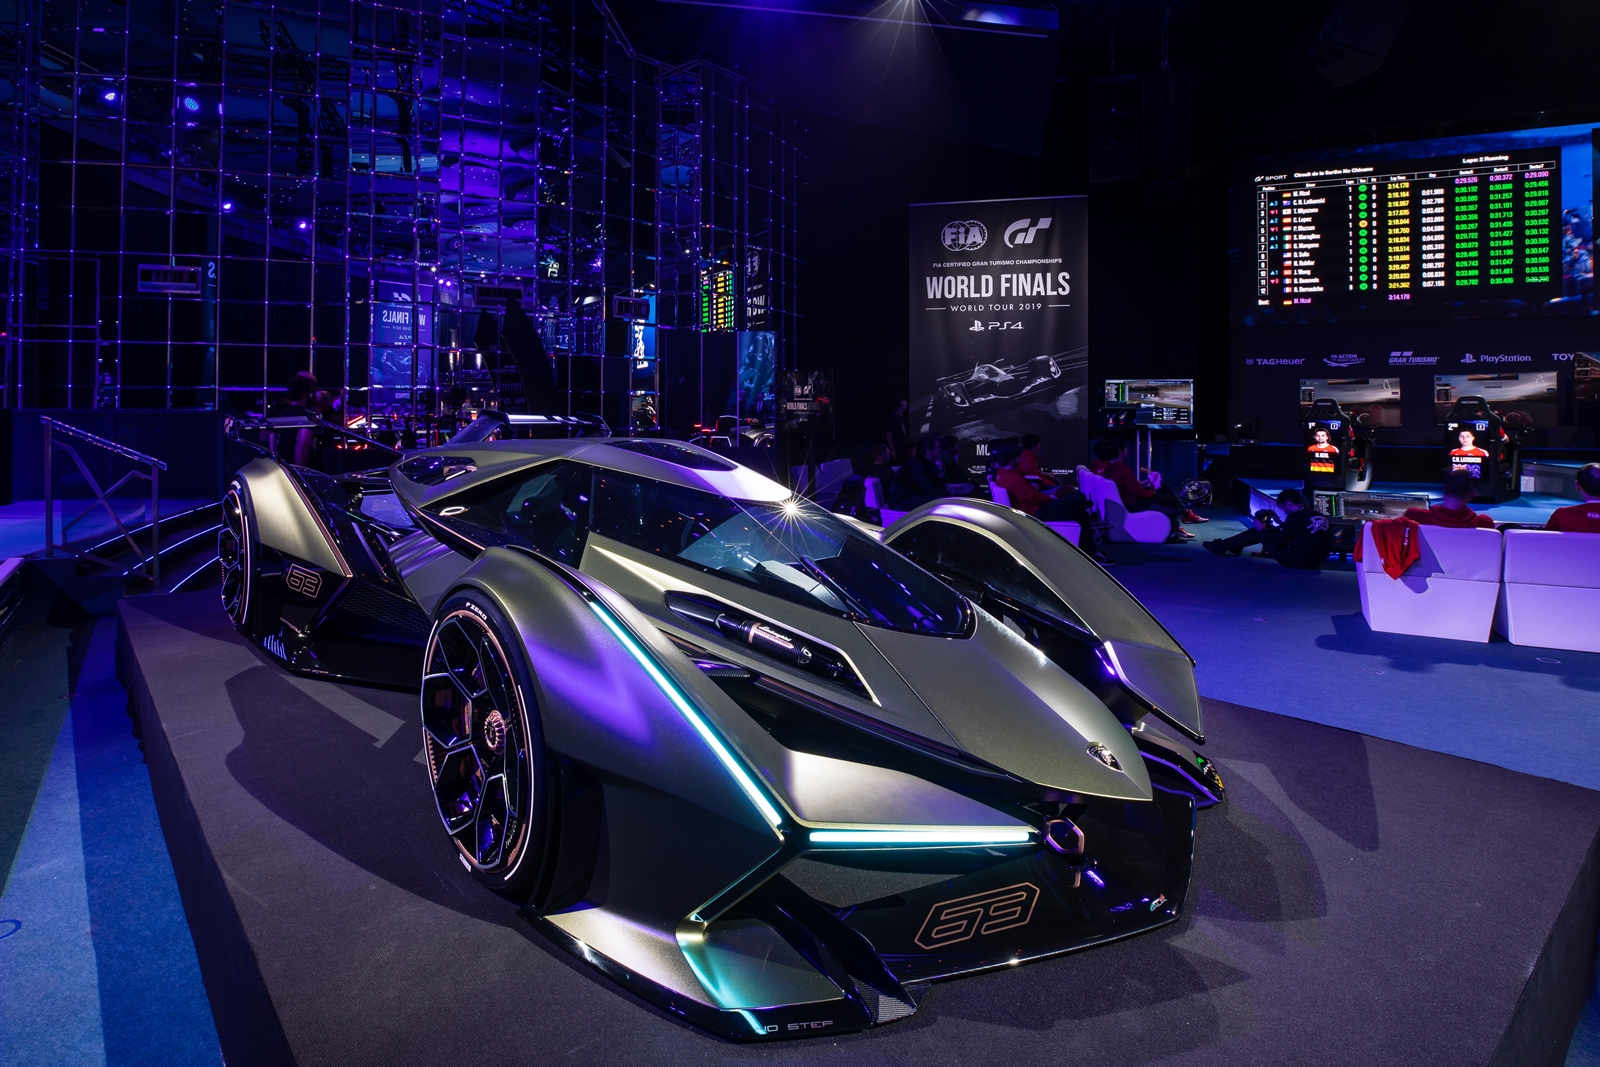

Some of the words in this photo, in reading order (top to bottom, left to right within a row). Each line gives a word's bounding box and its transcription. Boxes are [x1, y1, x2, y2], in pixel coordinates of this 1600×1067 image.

[926, 275, 993, 299] WORLD
[1000, 272, 1070, 297] FINALS
[988, 322, 1022, 330] PS4
[1480, 354, 1531, 364] PlayStation
[470, 604, 487, 620] ZERO
[787, 1020, 833, 1030] STEP
